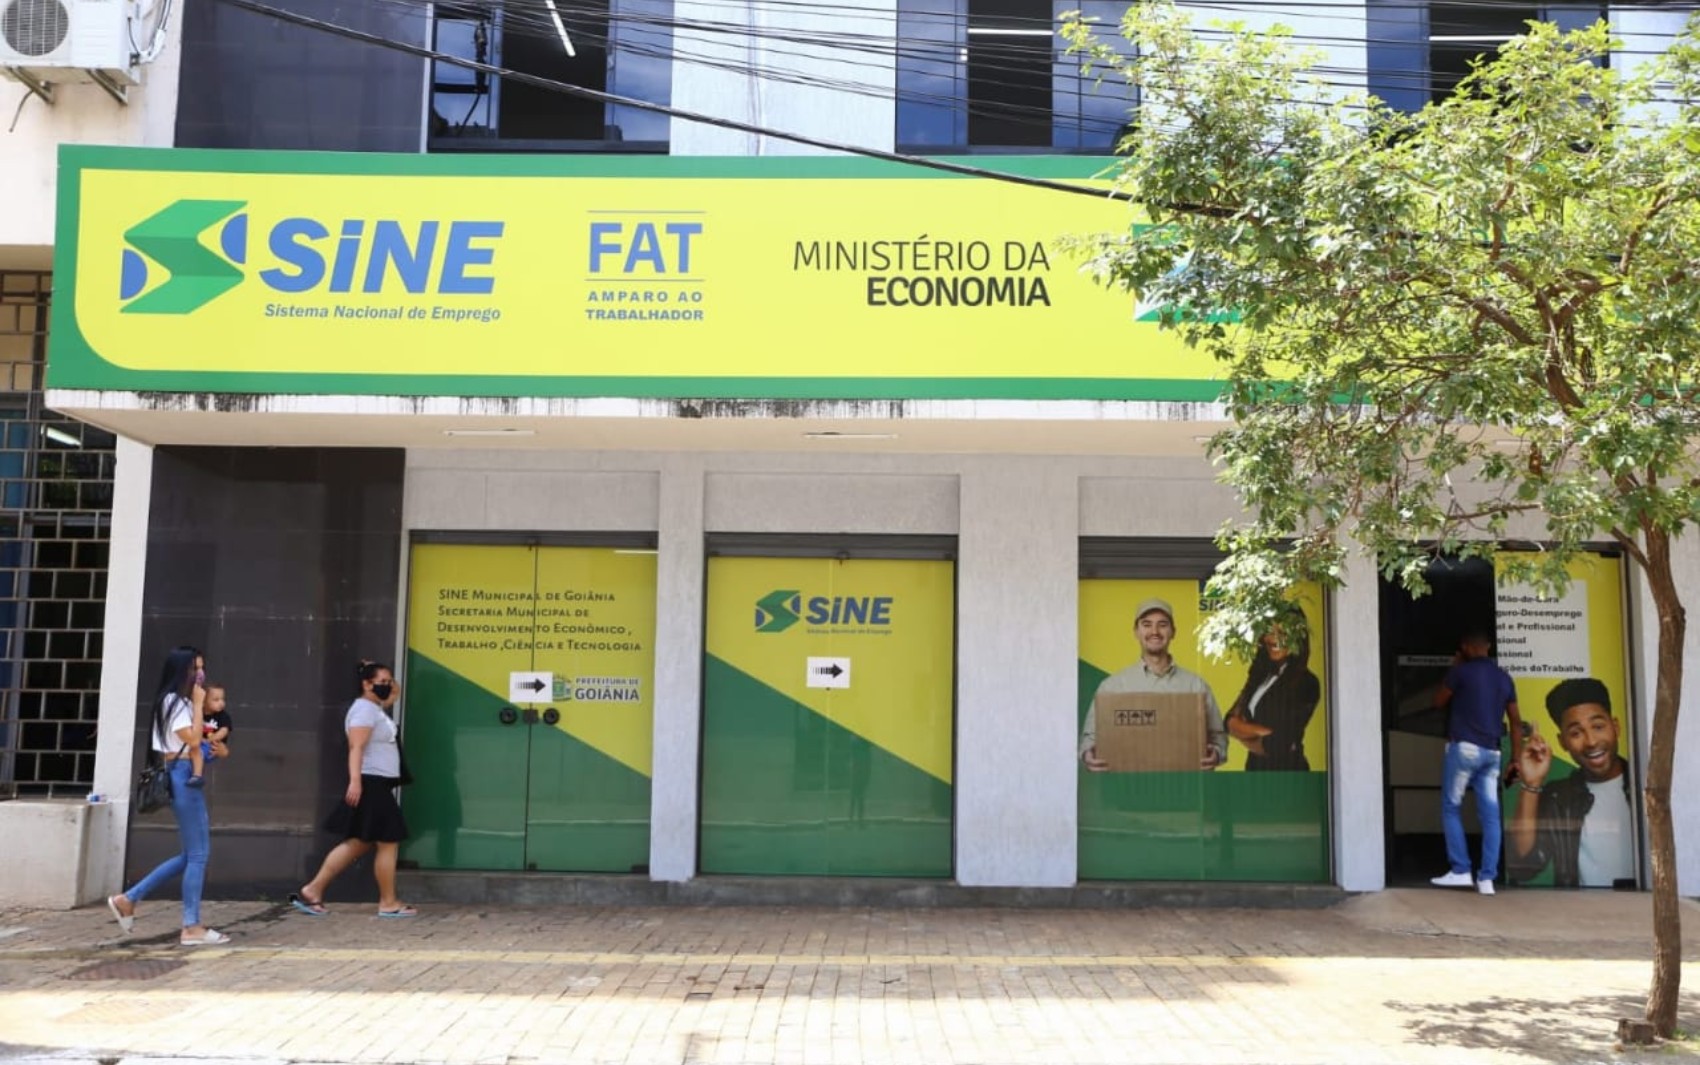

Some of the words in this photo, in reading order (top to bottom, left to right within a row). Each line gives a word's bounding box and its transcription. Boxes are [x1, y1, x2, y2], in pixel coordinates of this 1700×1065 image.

[589, 222, 703, 273] FAT
[793, 234, 991, 271] MINISTÉRIO
[1004, 241, 1051, 271] DA
[588, 290, 668, 303] AMPARO
[677, 291, 703, 303] AO
[867, 276, 1051, 307] ECONOMIA
[264, 303, 329, 318] Sistema
[333, 305, 403, 319] Nacional
[407, 306, 426, 319] de
[430, 306, 501, 323] Emprego
[585, 309, 704, 321] TRABALHADOR
[439, 589, 468, 600] SINE
[1517, 622, 1576, 632] Profissional
[575, 677, 627, 685] PREFEITURA
[574, 685, 640, 701] GOIÂNIA
